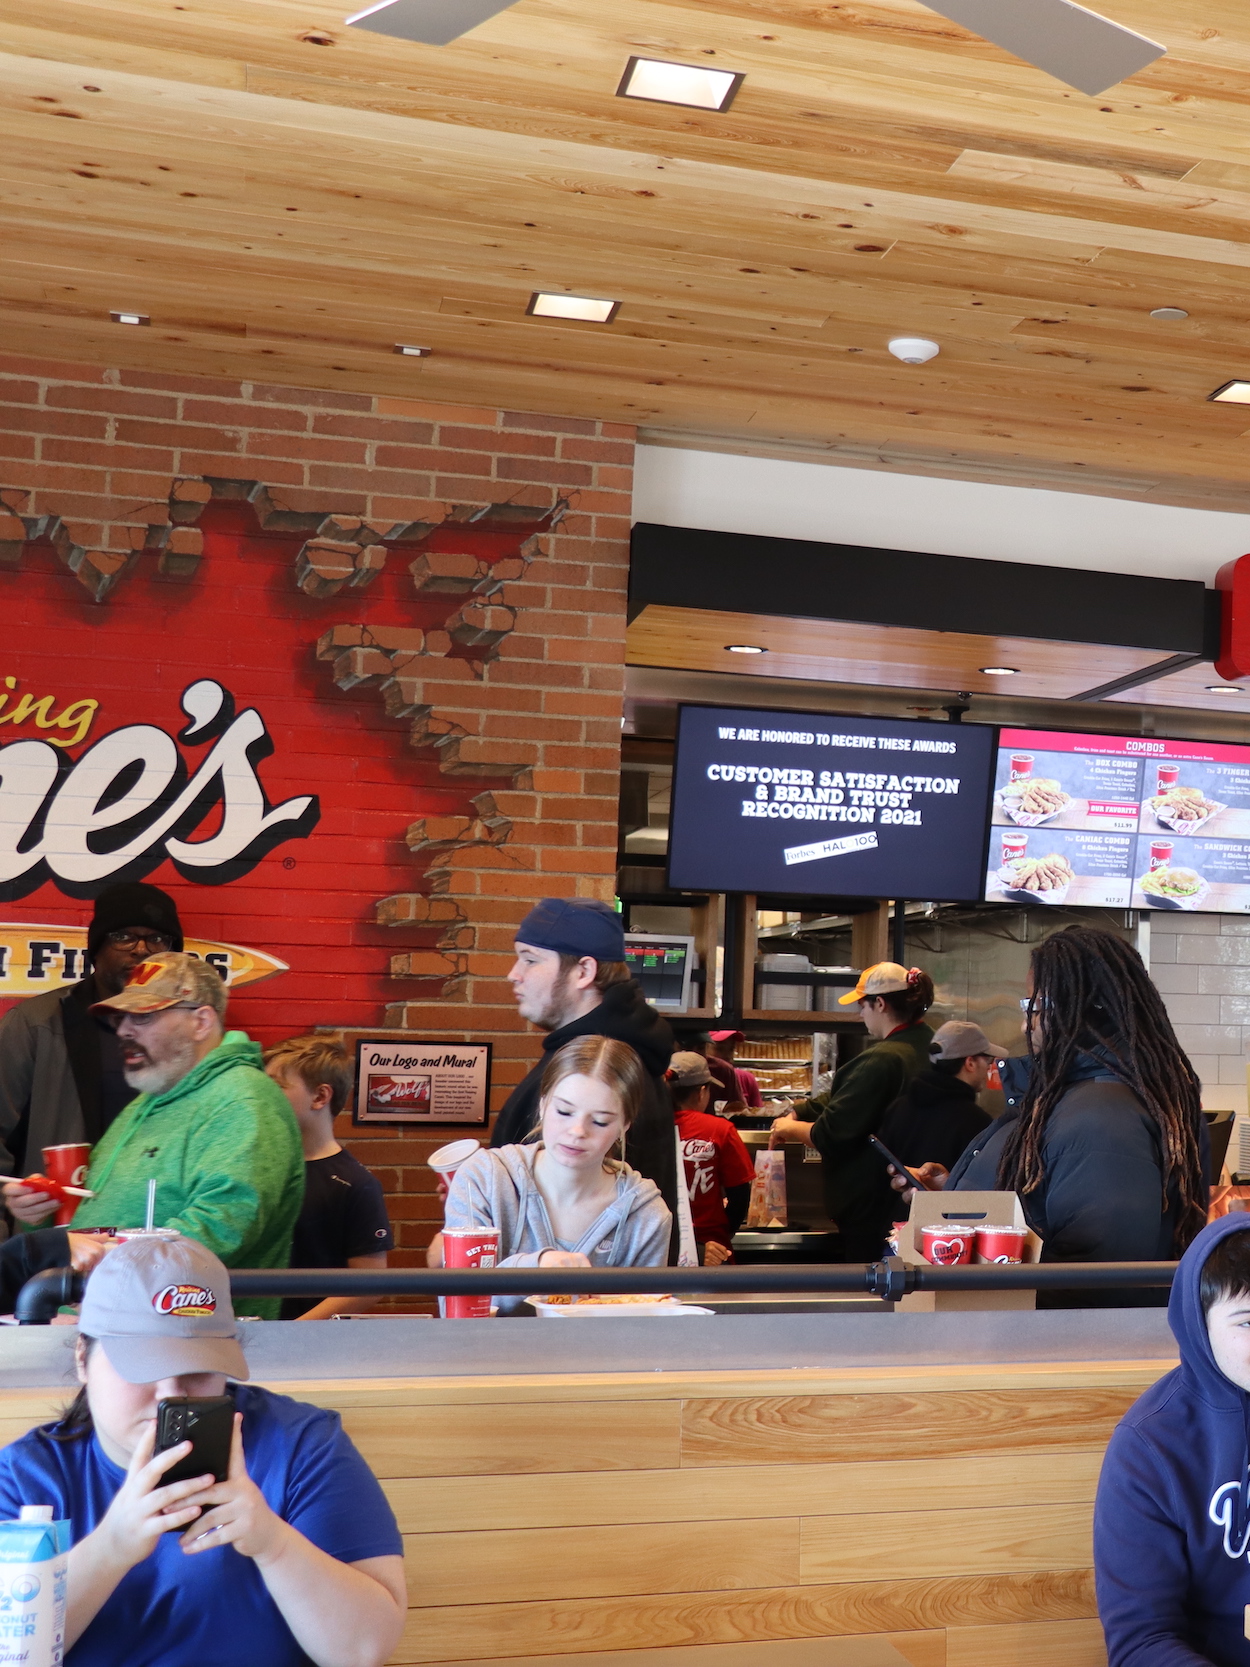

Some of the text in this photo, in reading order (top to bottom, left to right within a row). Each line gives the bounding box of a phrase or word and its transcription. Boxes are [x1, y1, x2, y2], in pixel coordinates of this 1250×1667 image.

[719, 727, 956, 753] WE ARE HONORED TO RECEIVE THESE AWARDS
[1126, 741, 1164, 752] COMBOS
[1096, 759, 1111, 767] BOX
[1112, 760, 1138, 768] COMBO
[1223, 768, 1250, 776] FINGER
[707, 764, 960, 794] CUSTOMER SATISFACTION
[756, 785, 912, 807] & BRAND TRUST
[742, 801, 922, 825] RECOGNITION 2021
[1104, 837, 1130, 845] COMBO
[1204, 843, 1242, 852] SANDWICH
[786, 848, 815, 861] Forbes
[370, 1053, 477, 1069] Our Logo and Mural
[466, 1245, 482, 1257] GET
[934, 1246, 952, 1256] OUR
[156, 1285, 216, 1314] Cane's
